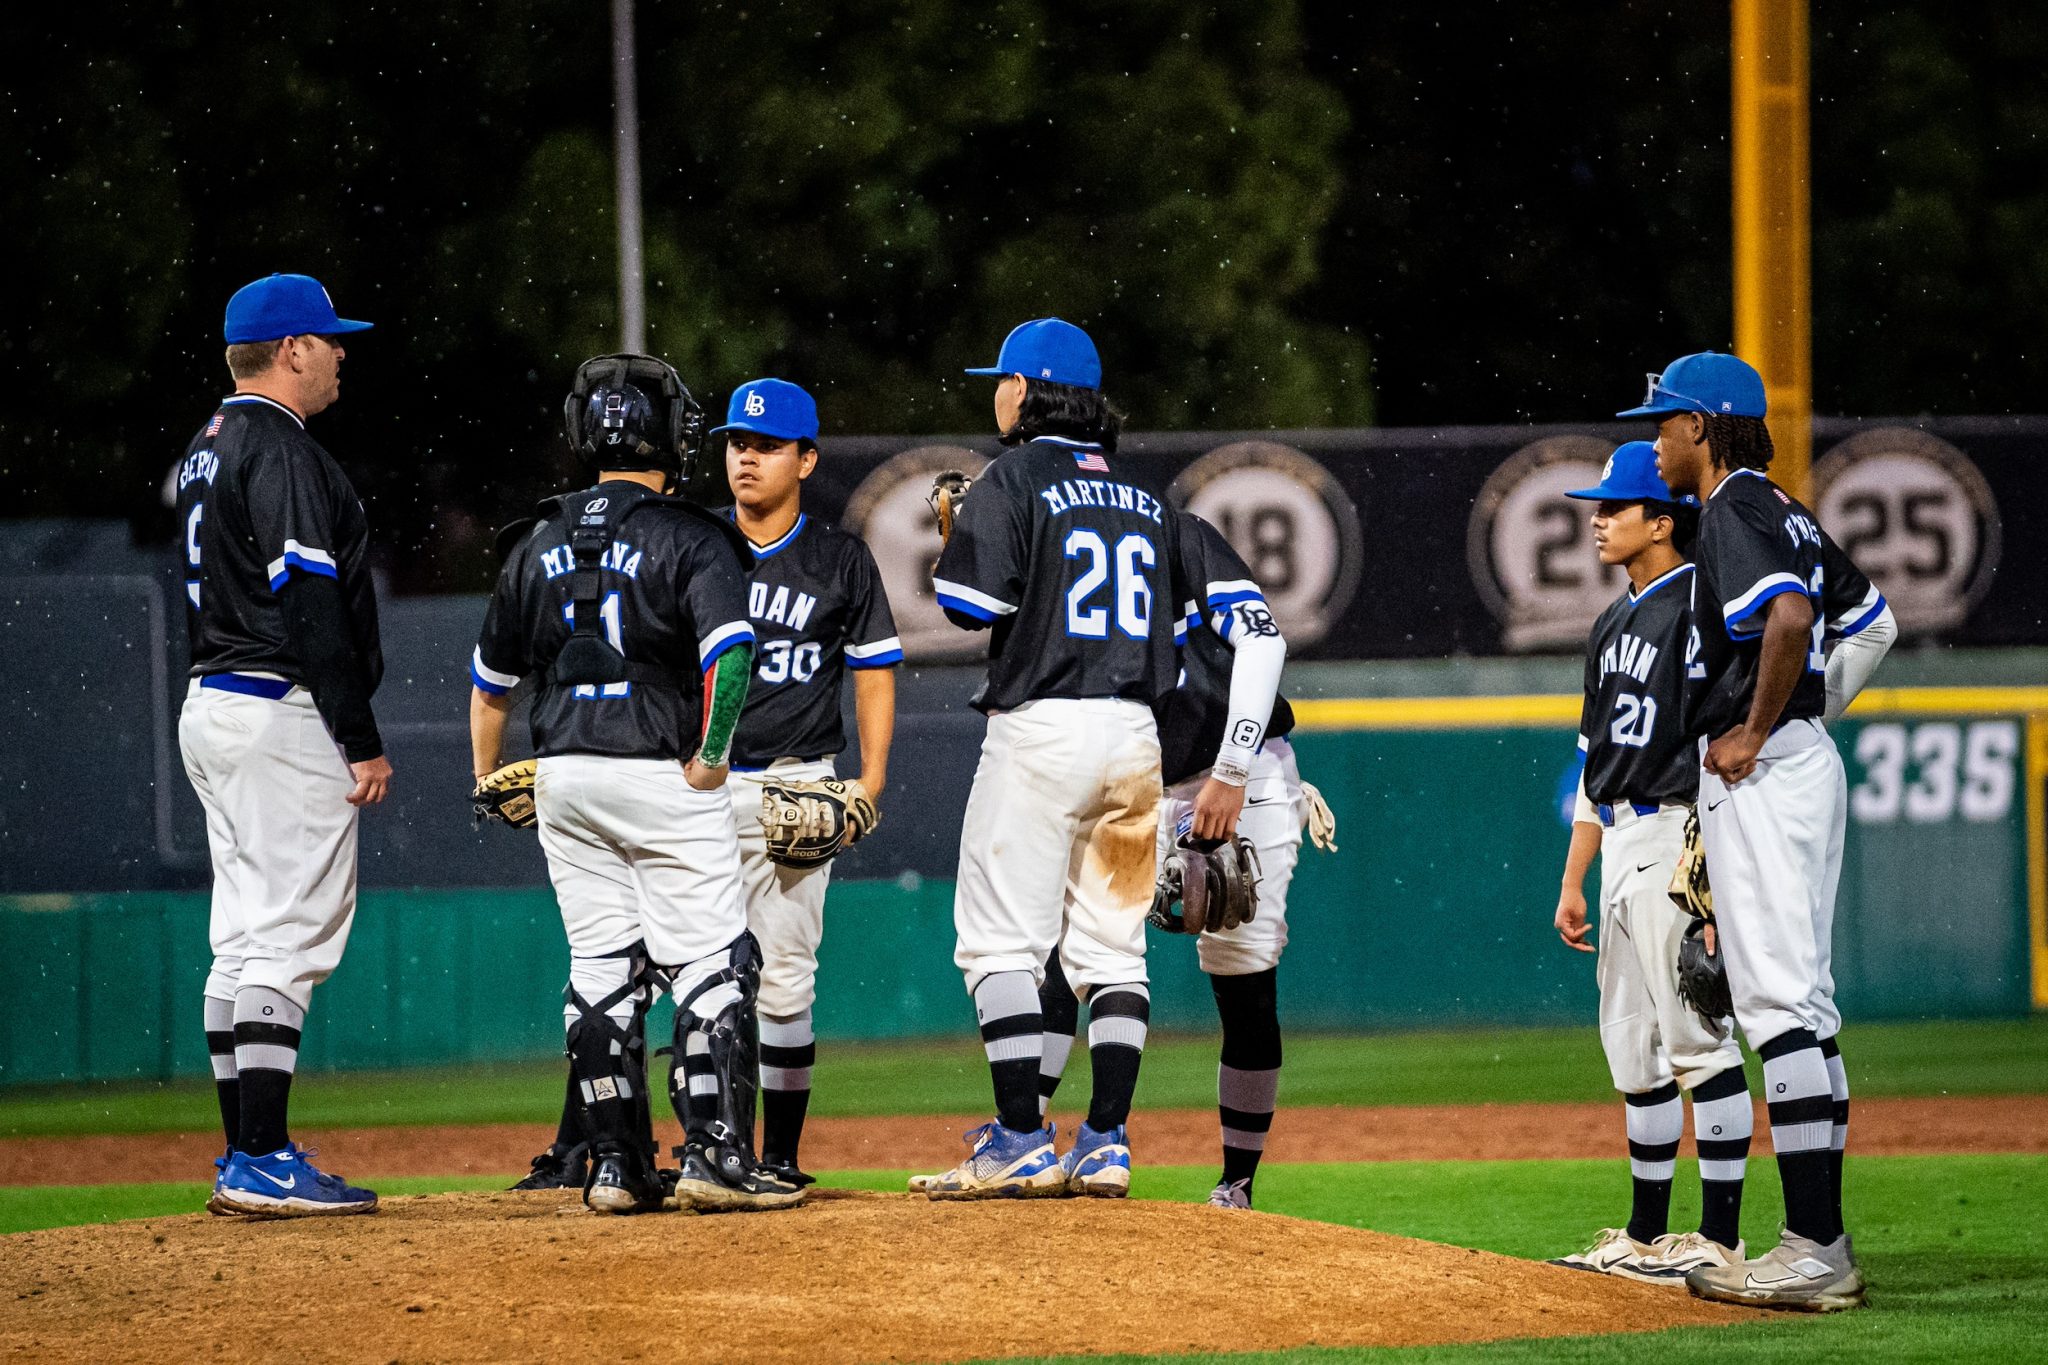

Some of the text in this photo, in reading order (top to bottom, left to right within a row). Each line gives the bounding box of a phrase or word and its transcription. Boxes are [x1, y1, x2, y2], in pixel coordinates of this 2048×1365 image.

[1040, 478, 1163, 525] MARTINEZ
[1841, 490, 1950, 579] 25
[1535, 502, 1616, 588] 2
[1063, 527, 1157, 641] 26
[758, 639, 823, 684] 30
[1231, 718, 1262, 749] 8
[1611, 692, 1658, 749] 20
[1848, 720, 2020, 824] 335
